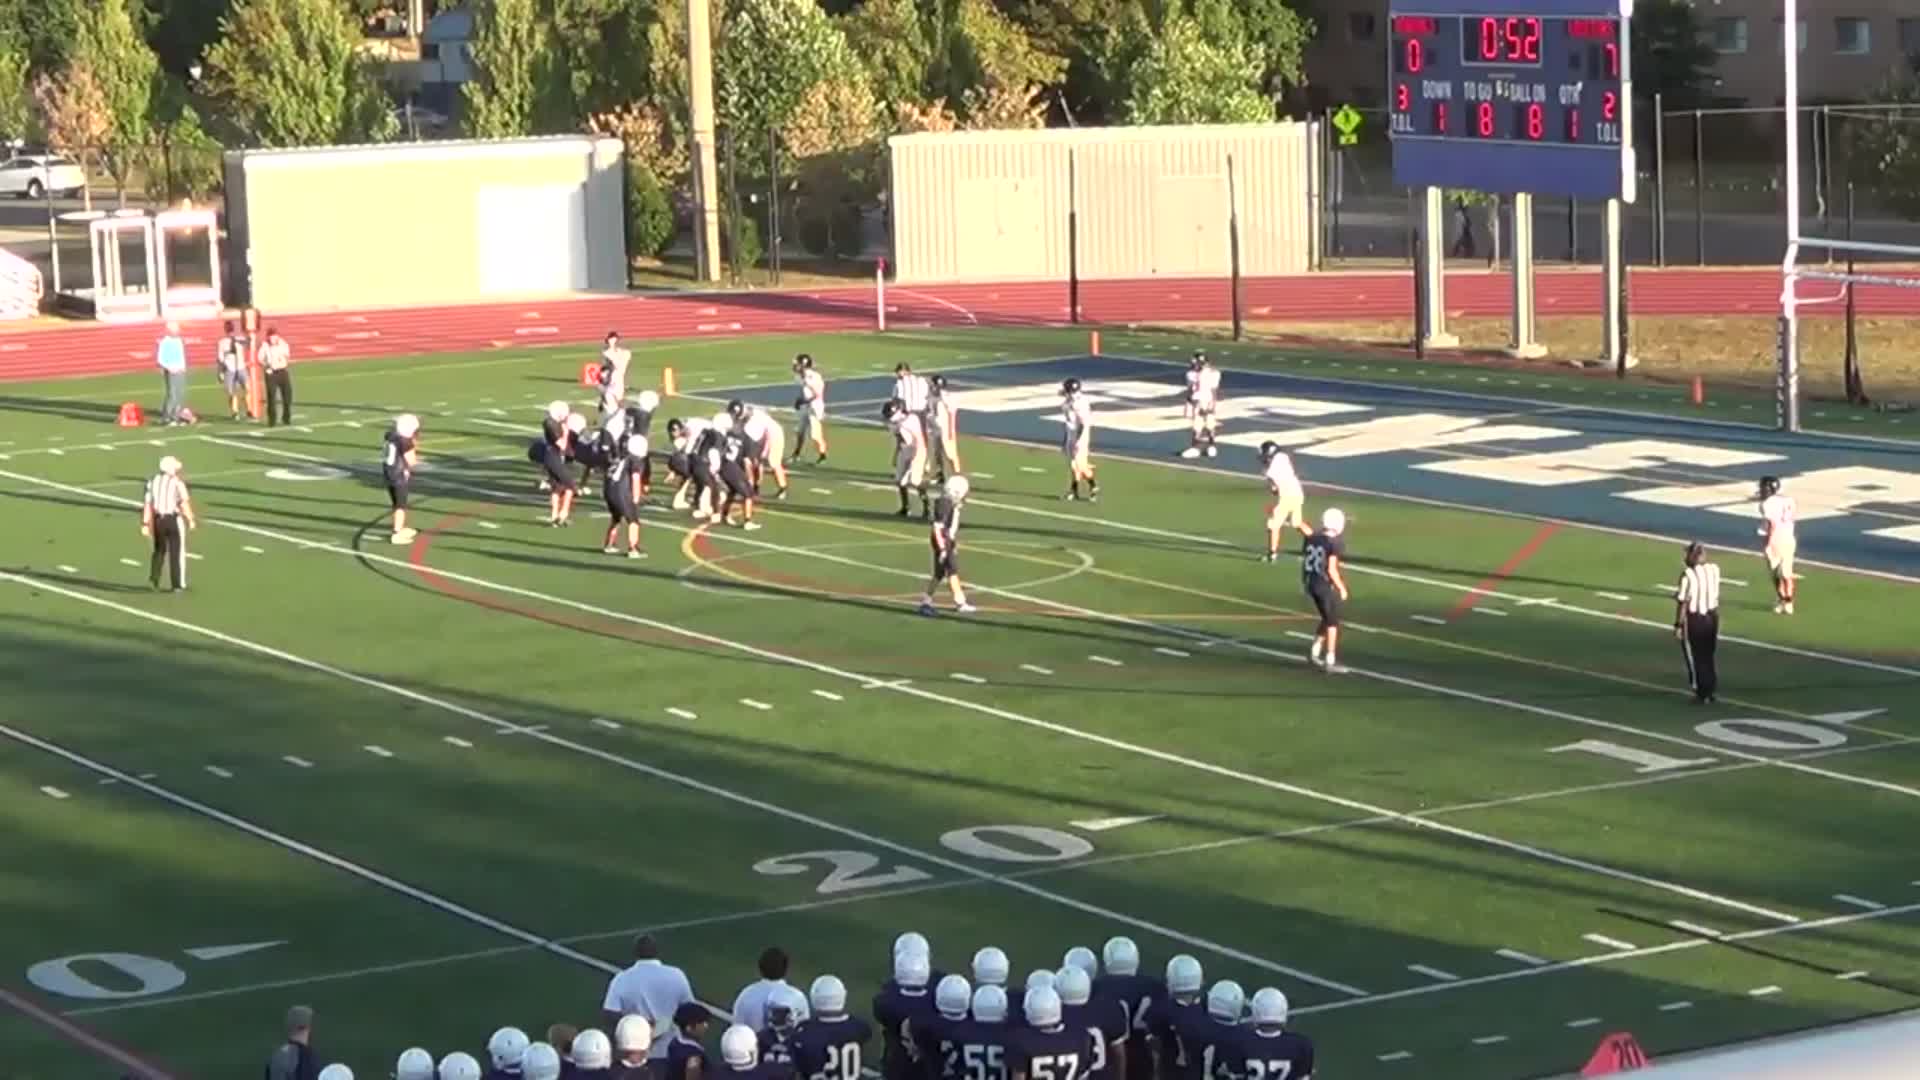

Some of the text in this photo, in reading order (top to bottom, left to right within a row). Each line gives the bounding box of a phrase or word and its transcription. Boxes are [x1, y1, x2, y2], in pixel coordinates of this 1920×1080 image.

[1481, 17, 1540, 60] 0:52
[1408, 39, 1420, 72] 0
[1605, 43, 1617, 76] 7
[1398, 84, 1409, 110] 3
[1422, 80, 1452, 99] DOWN
[1464, 81, 1476, 100] TO
[1478, 82, 1492, 101] GO
[1532, 84, 1546, 103] ON
[1479, 102, 1493, 136] 8
[1603, 92, 1616, 119] 2
[1528, 104, 1542, 138] 8
[1032, 1053, 1079, 1080] 57
